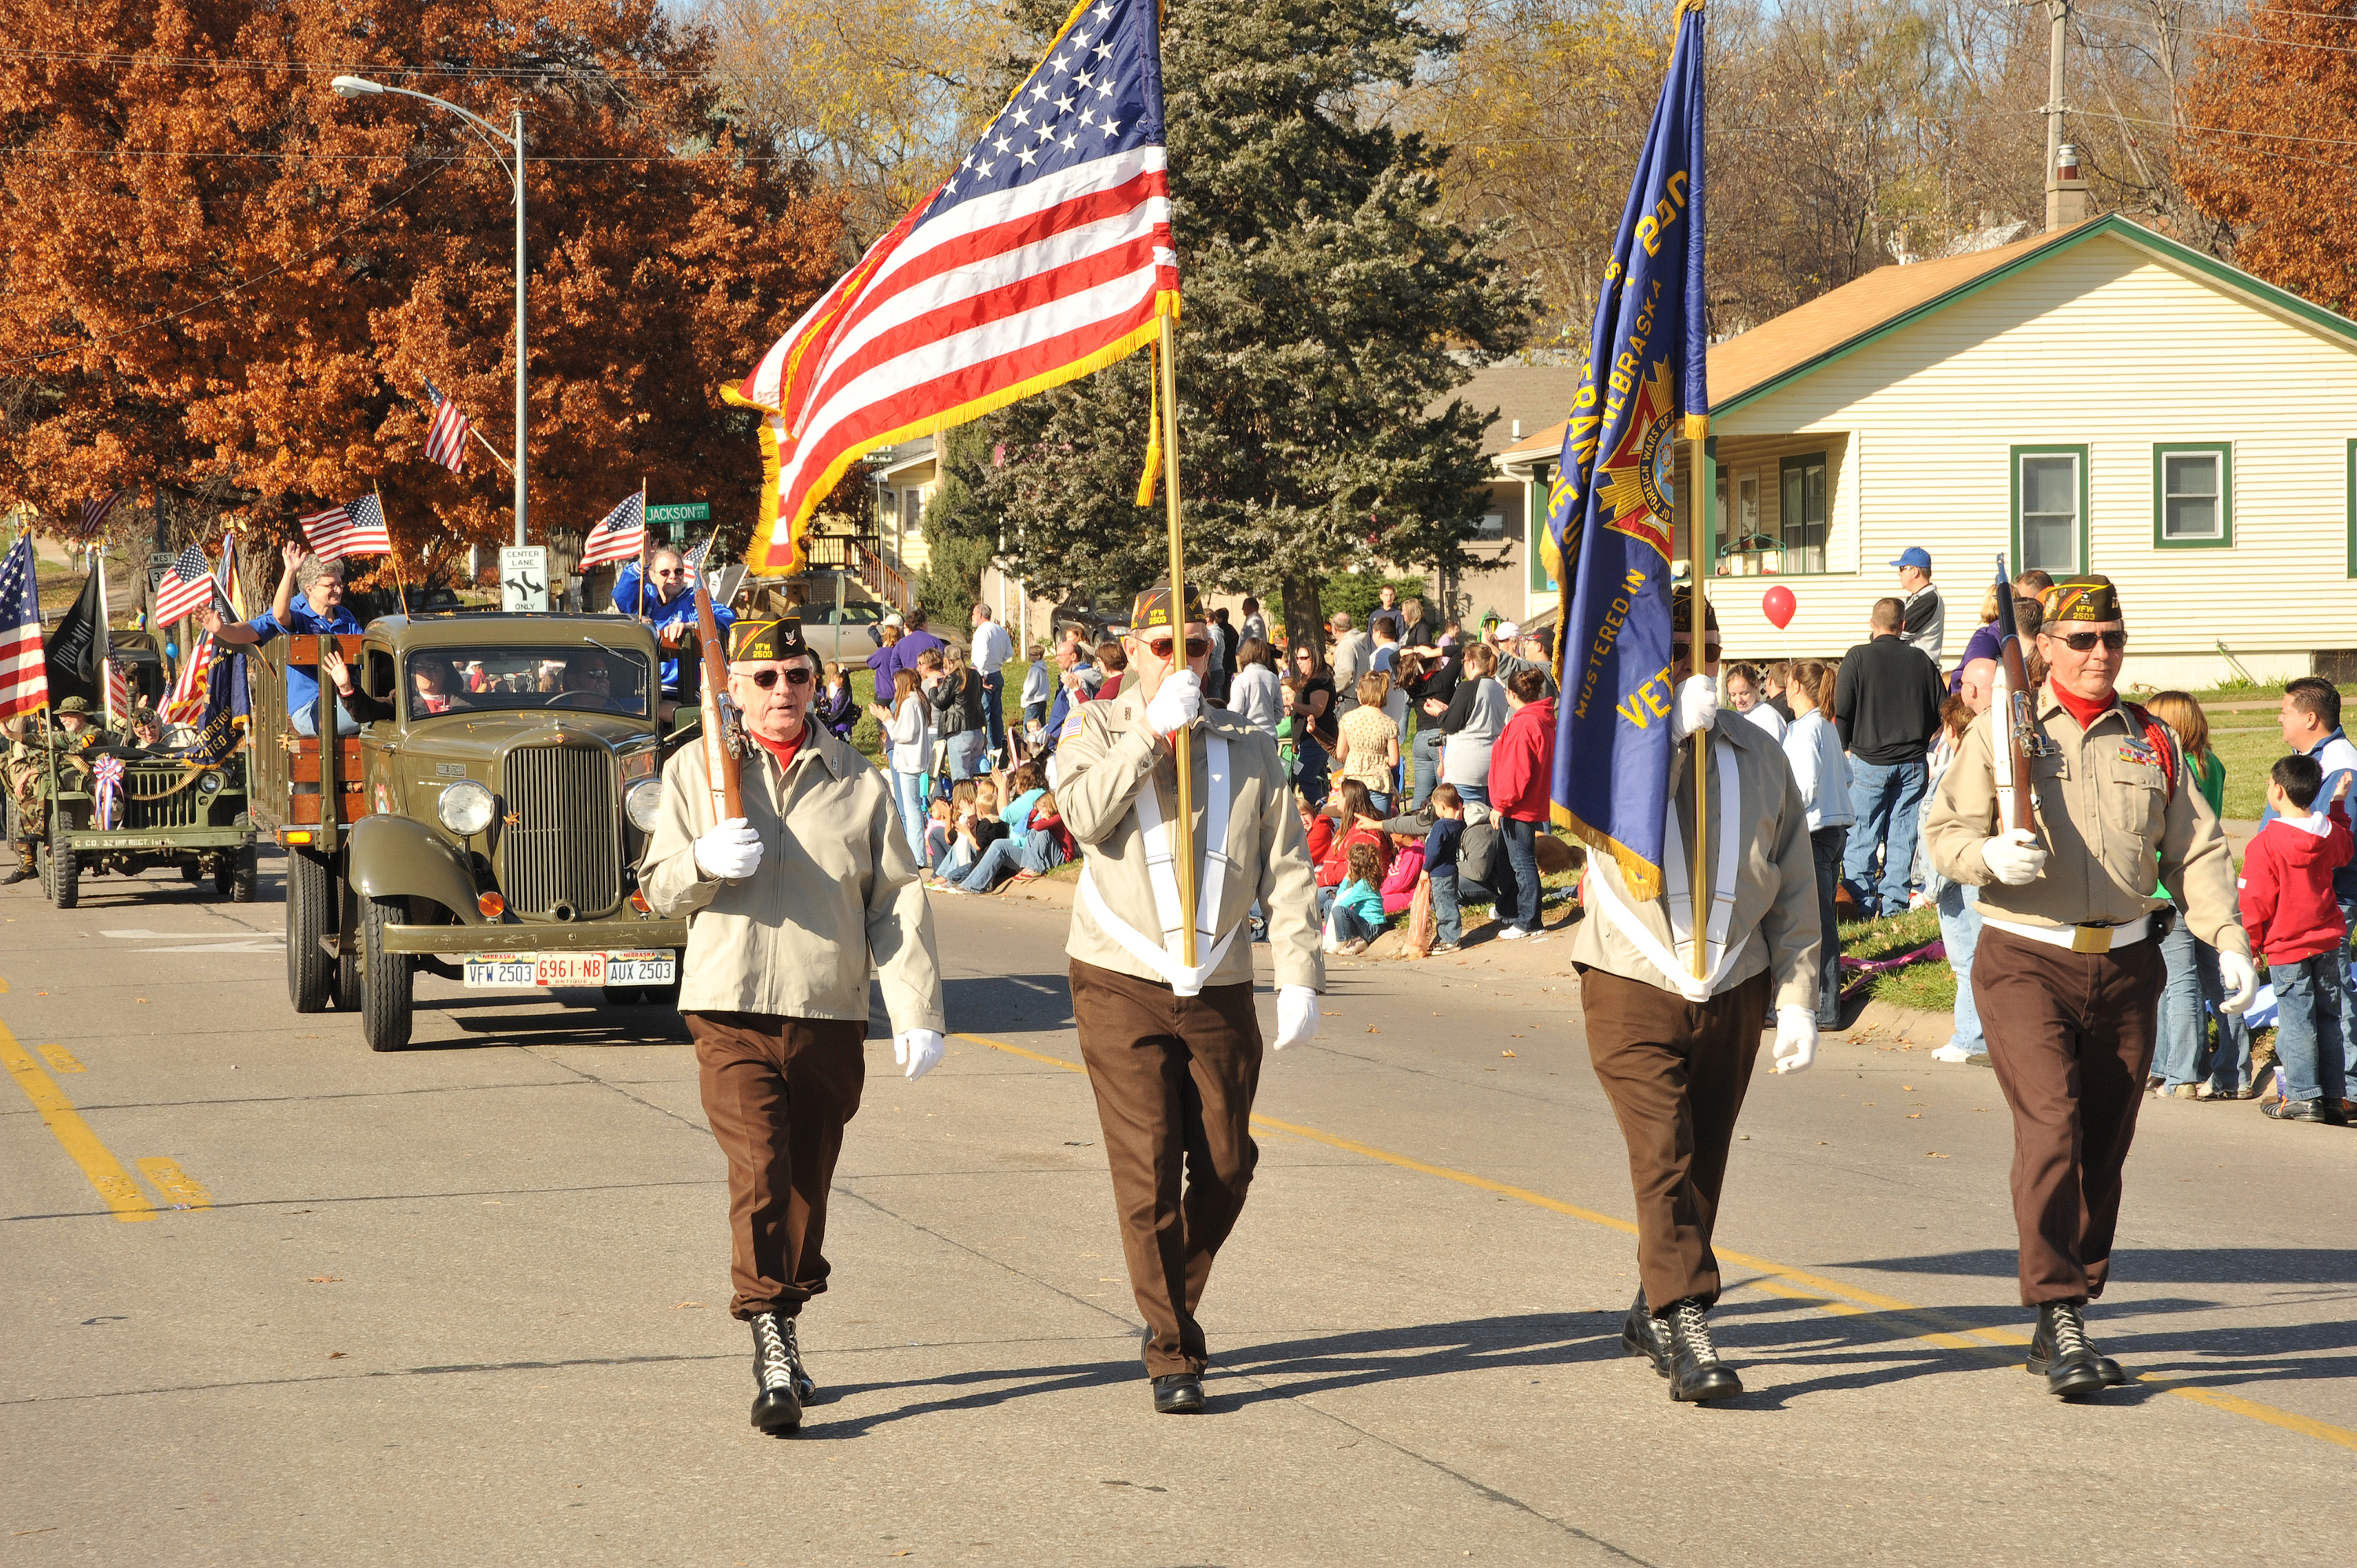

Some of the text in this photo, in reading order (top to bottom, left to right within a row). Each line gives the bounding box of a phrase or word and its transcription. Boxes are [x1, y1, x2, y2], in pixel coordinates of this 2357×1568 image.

[1602, 278, 1662, 430] NEBRASKA
[1659, 414, 1669, 430] OF
[1642, 428, 1659, 460] WARS
[1641, 466, 1662, 511] FOREIGN
[646, 506, 695, 521] JACKSON
[152, 554, 172, 562] WEST
[1149, 608, 1165, 617] VFW
[1149, 616, 1167, 625] 2503
[1574, 568, 1646, 720] MUSTERED IN
[53, 639, 79, 676] POW
[207, 654, 225, 670] APRIL
[469, 965, 532, 982] VFW 2503
[610, 962, 671, 980] AUX 2503
